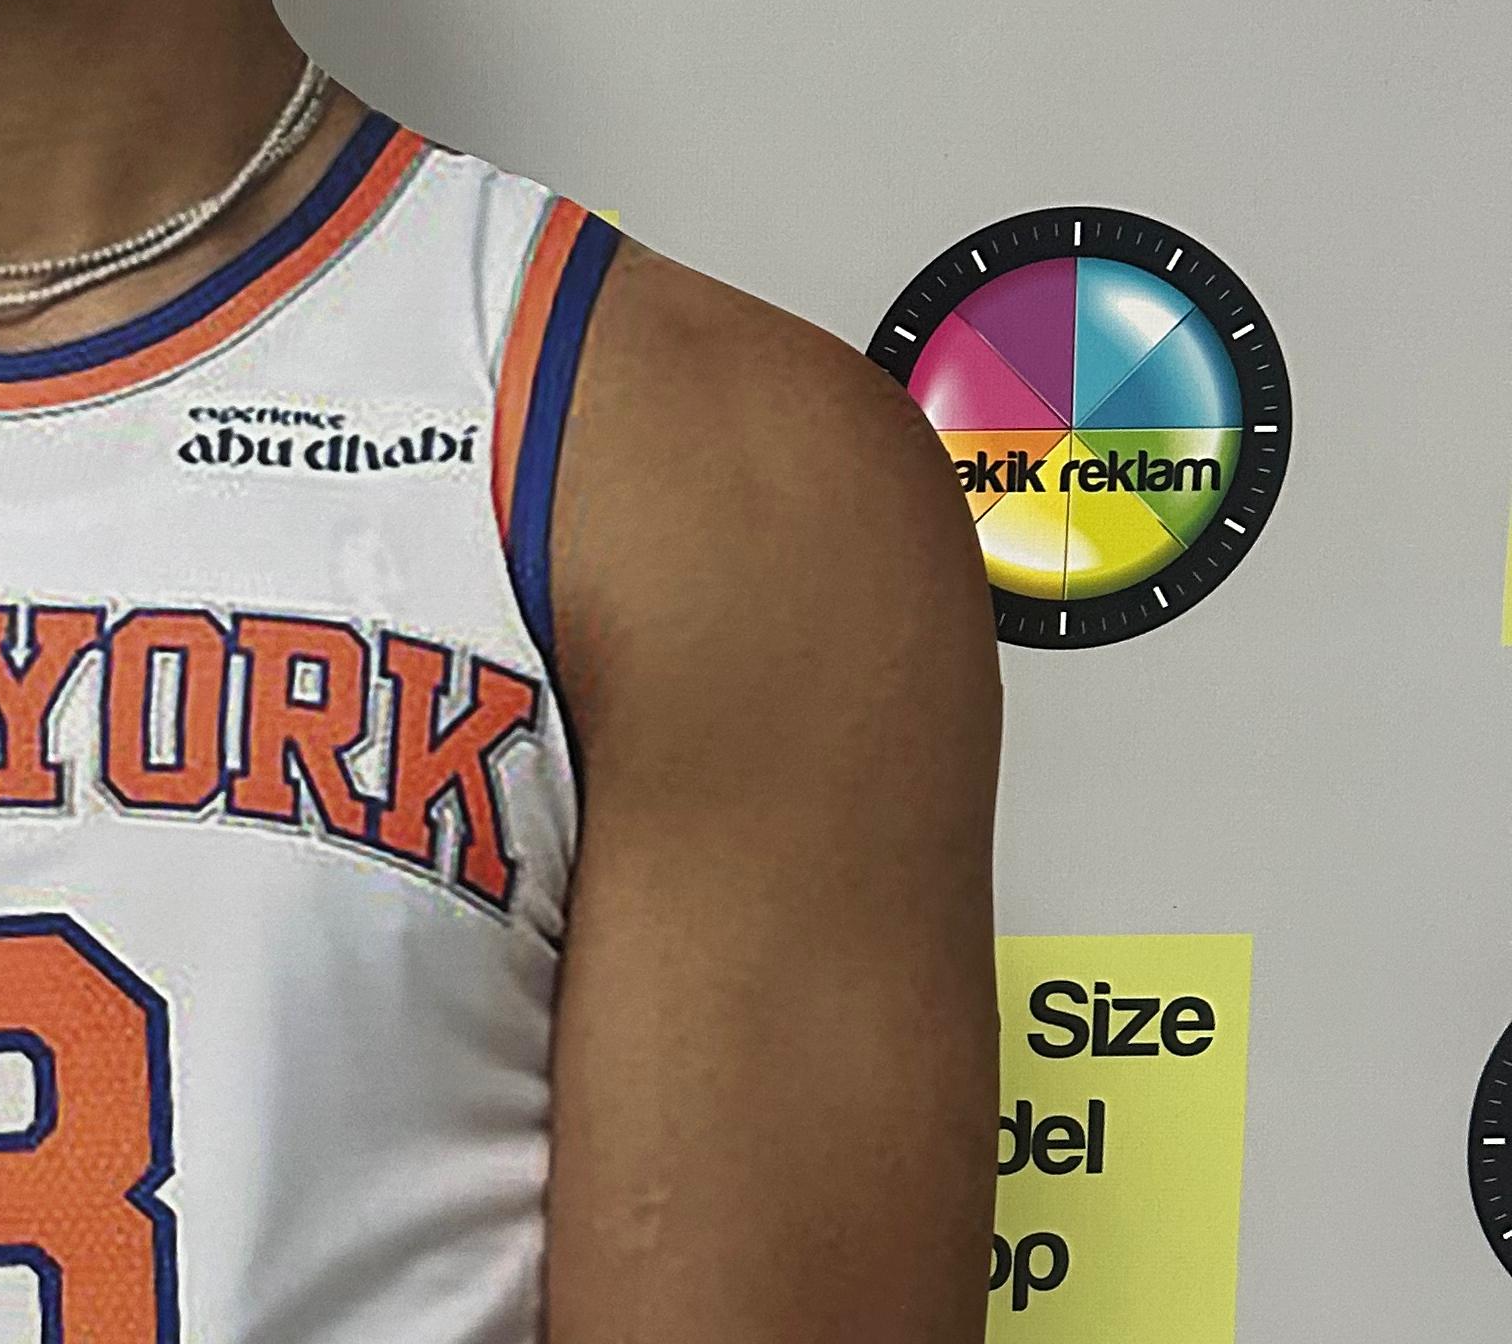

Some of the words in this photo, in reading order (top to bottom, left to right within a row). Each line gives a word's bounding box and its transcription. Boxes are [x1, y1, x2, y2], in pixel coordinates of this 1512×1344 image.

[178, 426, 294, 467] abu
[303, 424, 479, 473] dhabi
[953, 451, 1047, 494] akik
[1059, 450, 1222, 493] reklam
[1026, 980, 1216, 1059] Size
[997, 1099, 1105, 1176] del
